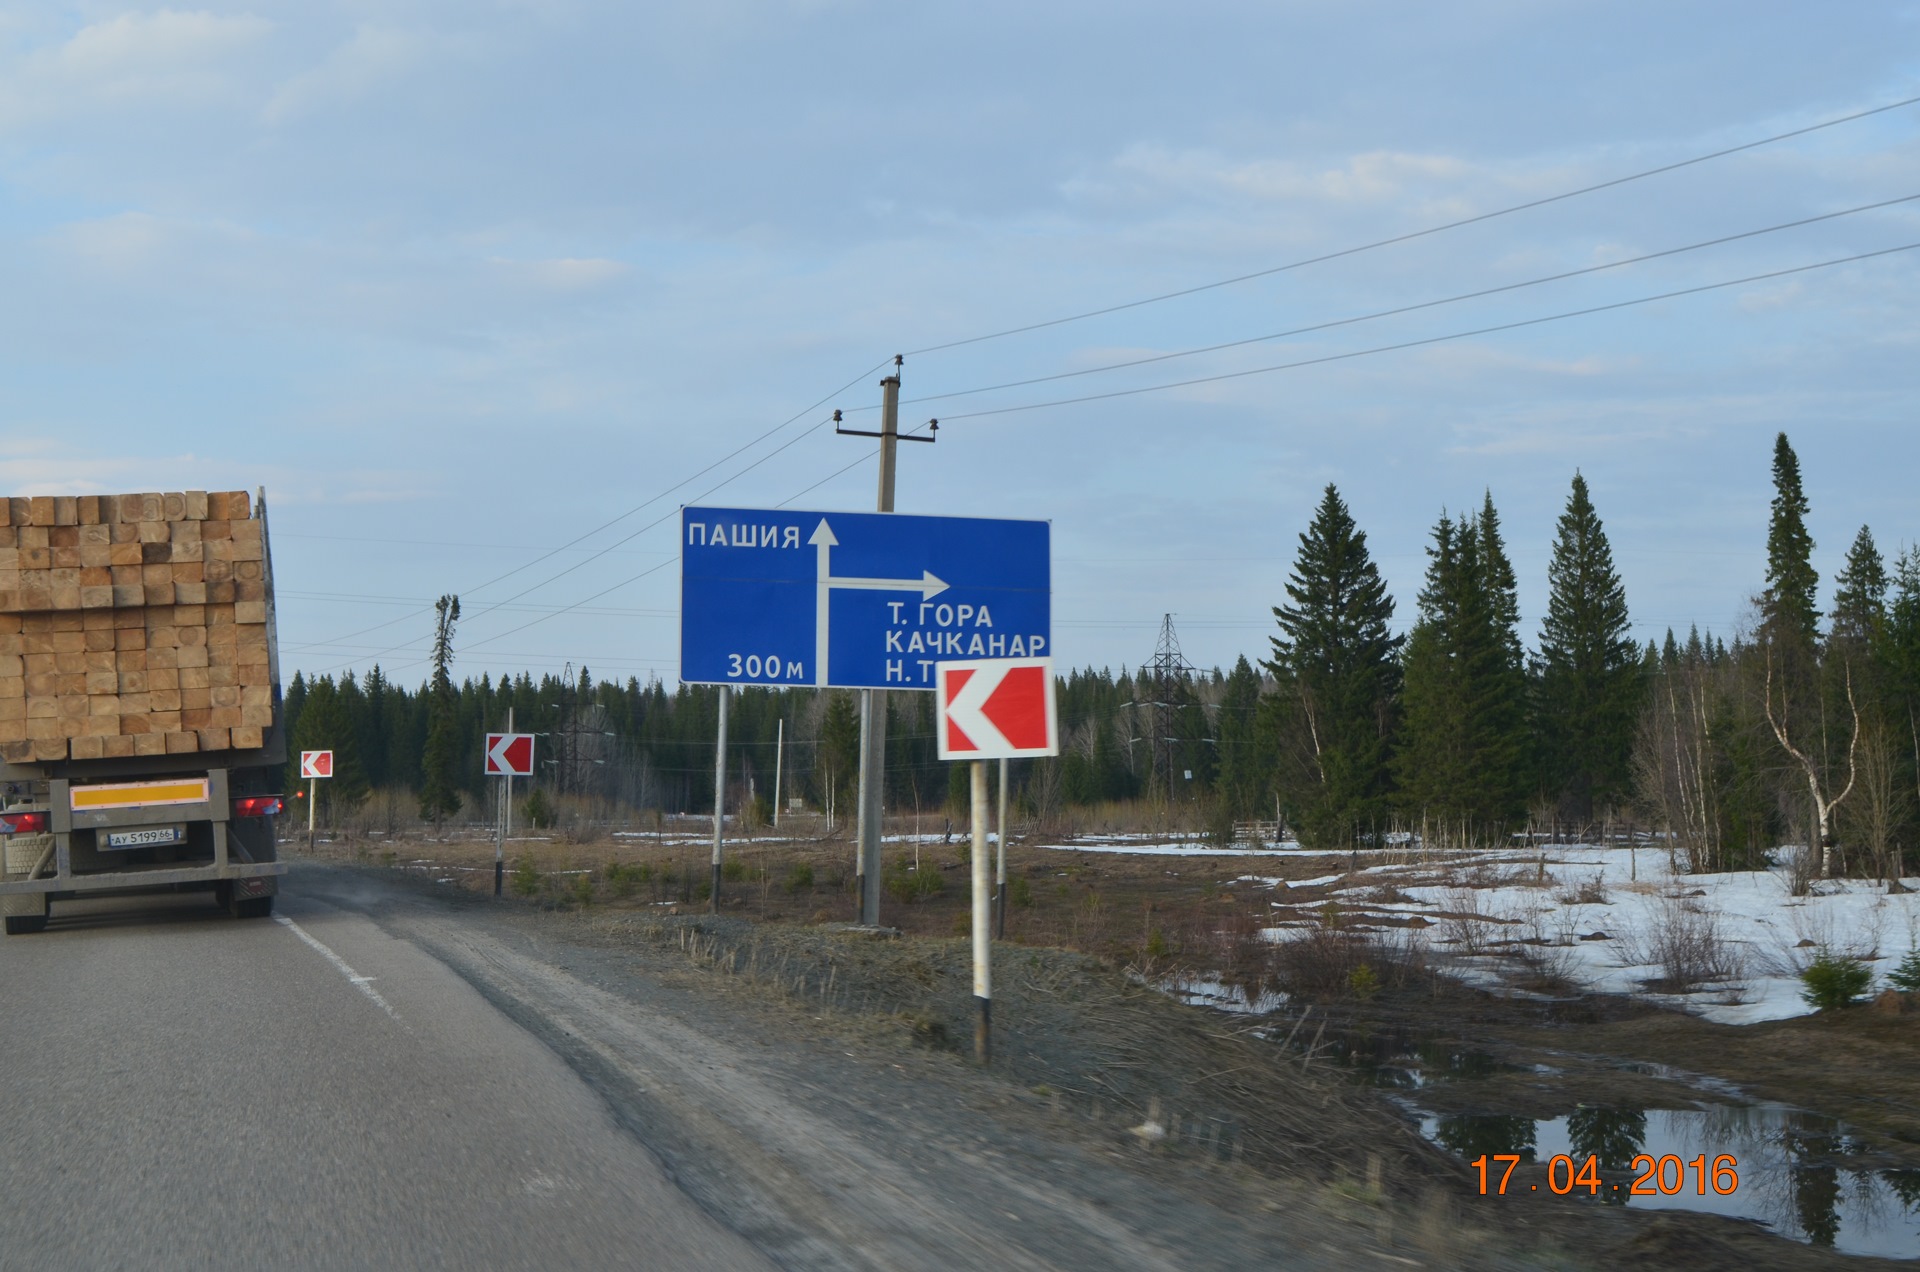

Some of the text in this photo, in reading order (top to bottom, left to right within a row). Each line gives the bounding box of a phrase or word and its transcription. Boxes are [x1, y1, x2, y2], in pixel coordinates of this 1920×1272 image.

[689, 522, 800, 549] ПАШИЯ
[887, 602, 993, 628] Т. ГОРА
[886, 630, 1046, 658] КАЧКАНАР
